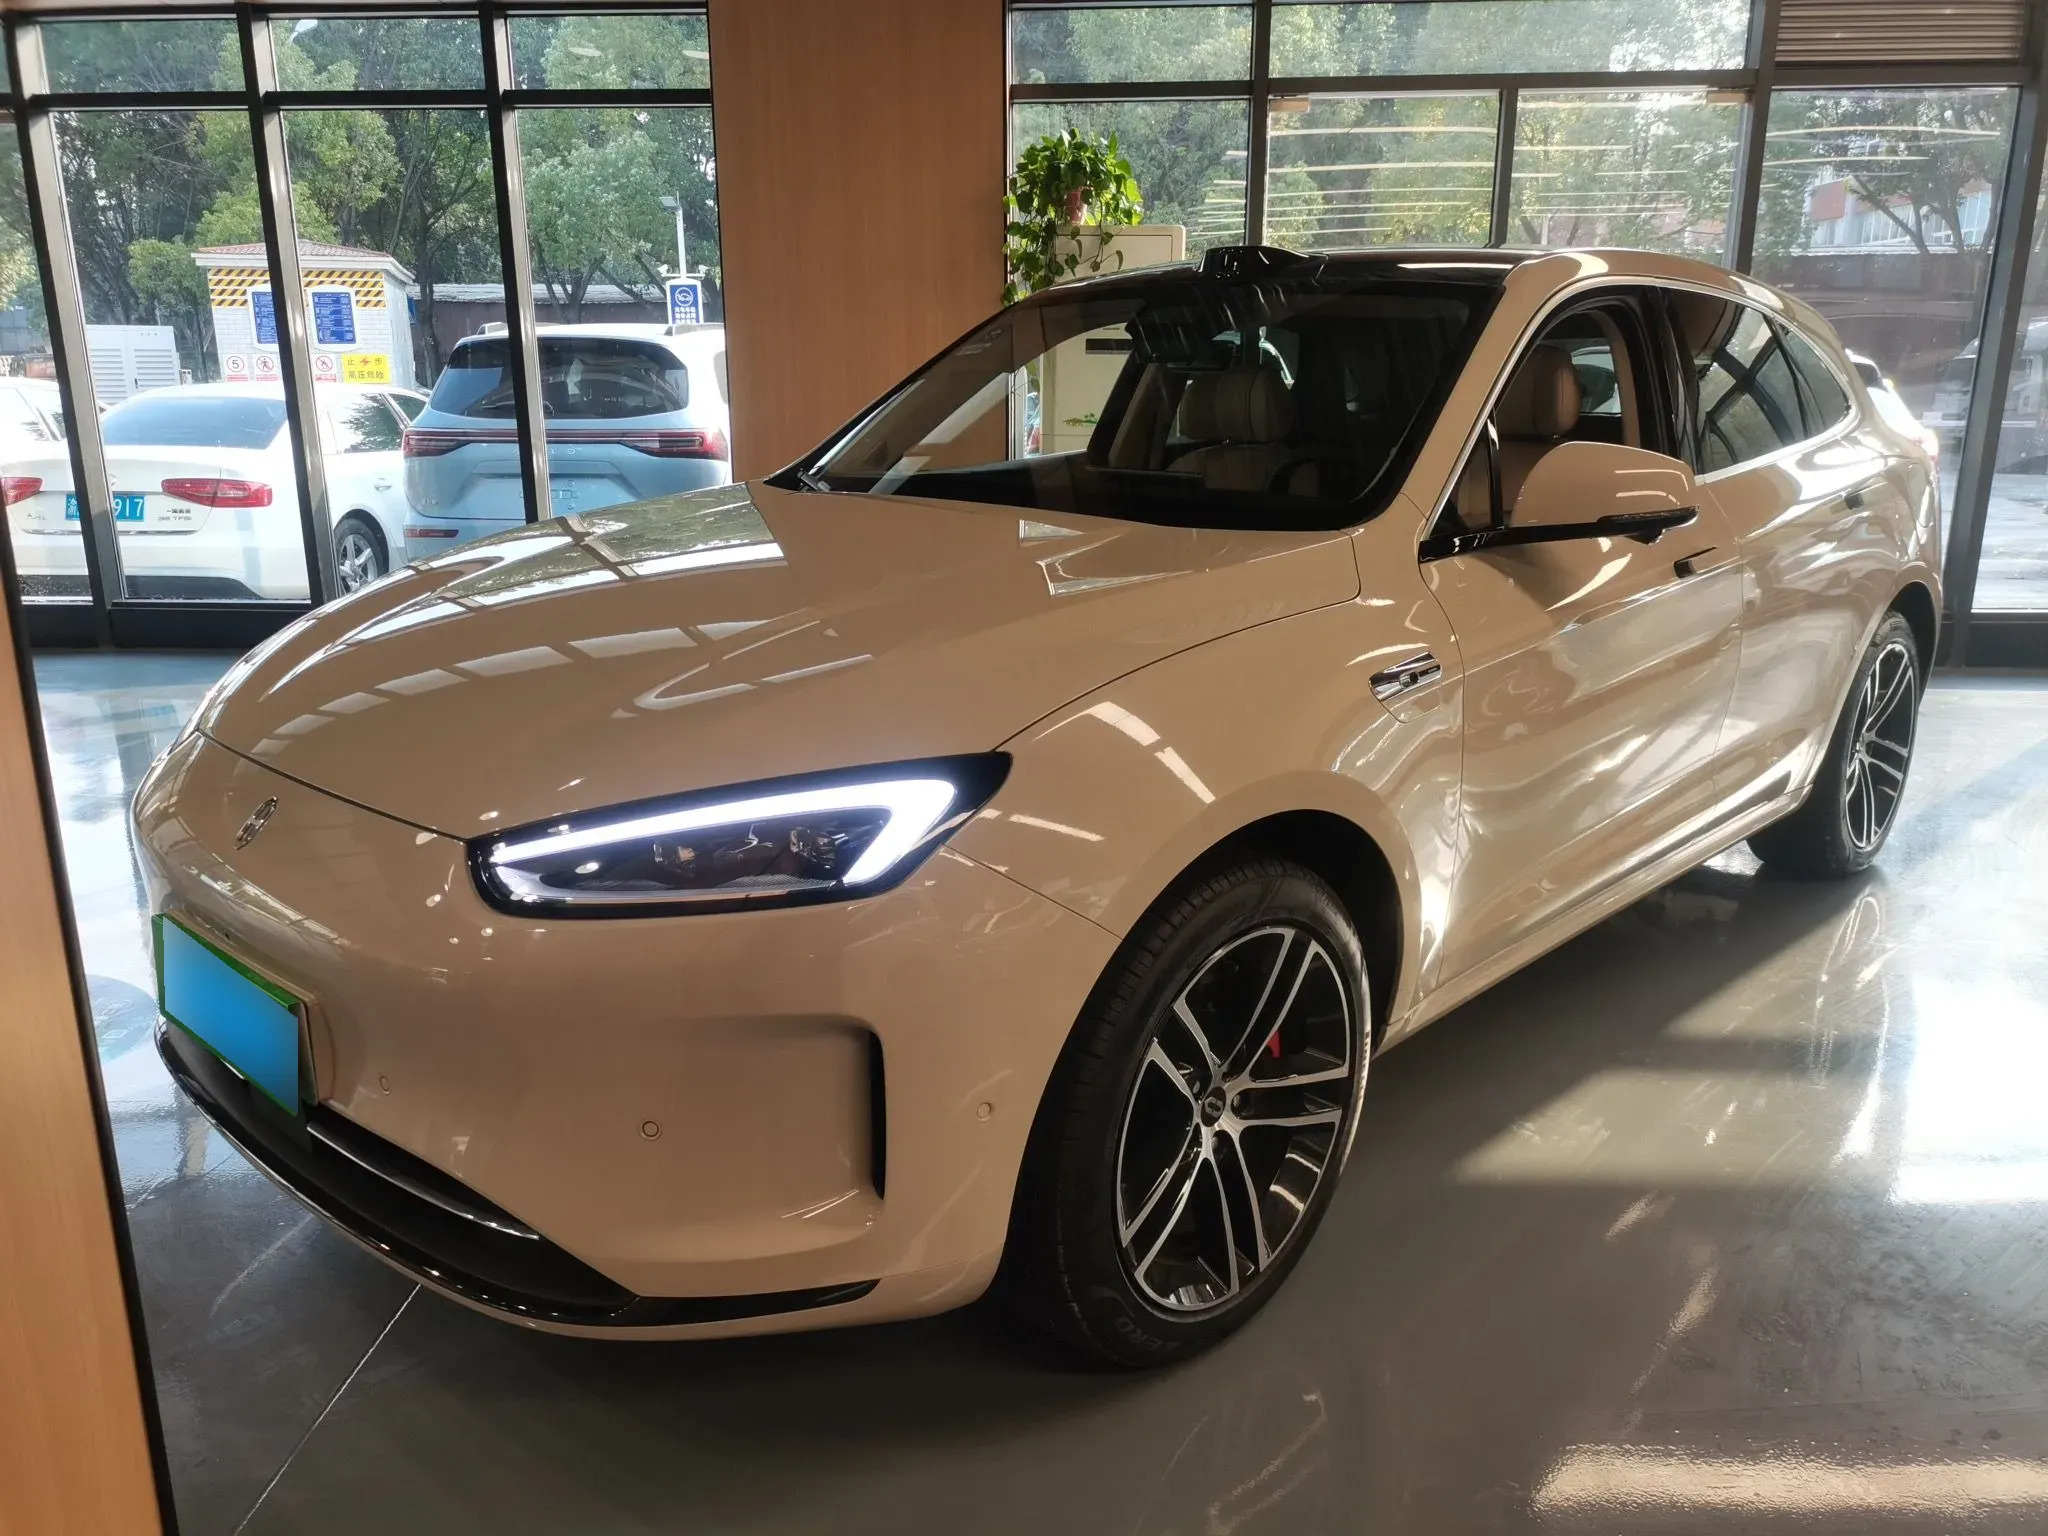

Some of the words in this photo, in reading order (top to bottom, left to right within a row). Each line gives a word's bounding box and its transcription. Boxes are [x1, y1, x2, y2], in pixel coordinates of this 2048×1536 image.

[231, 360, 240, 369] 5
[348, 370, 385, 379] 高压危险
